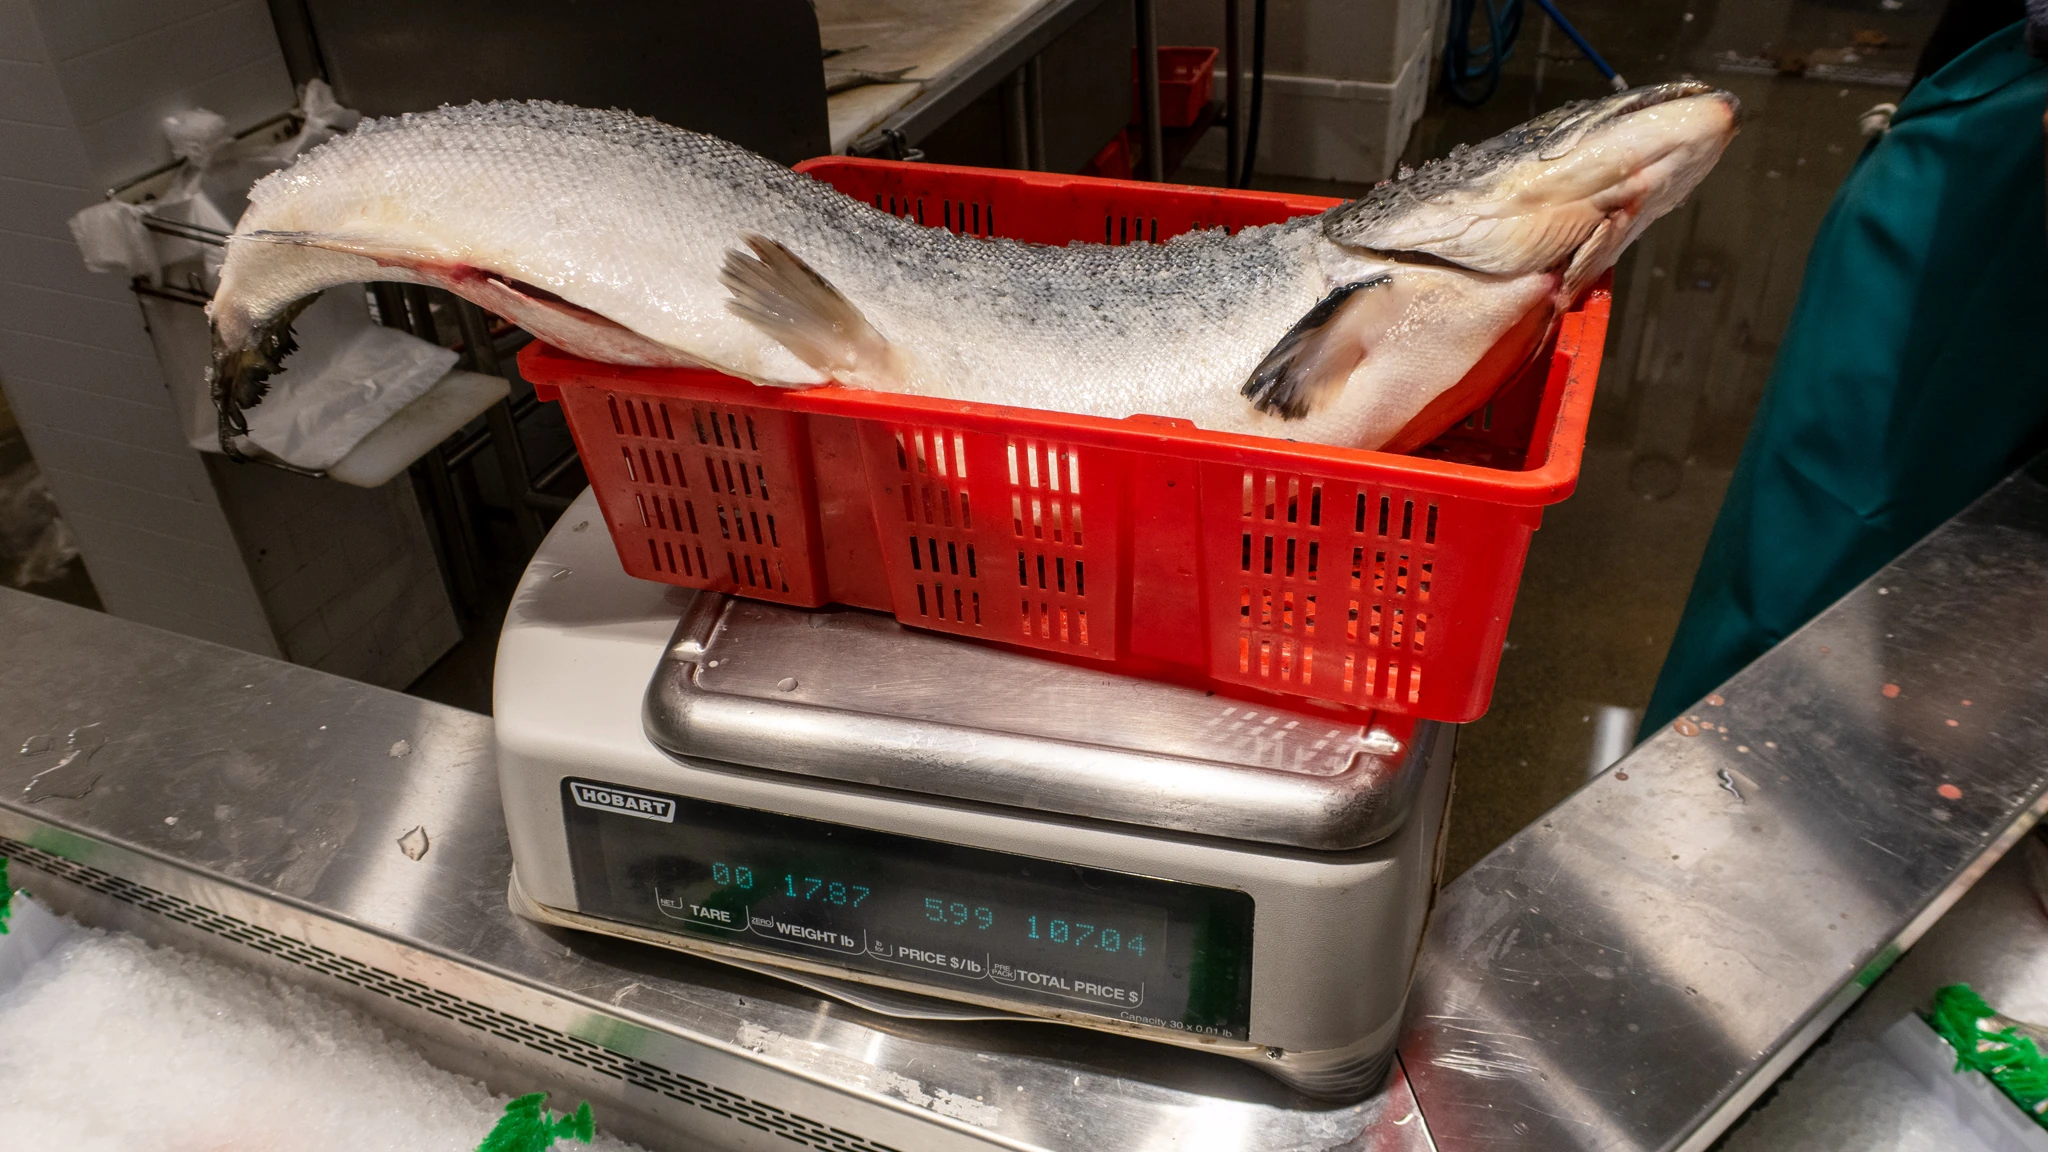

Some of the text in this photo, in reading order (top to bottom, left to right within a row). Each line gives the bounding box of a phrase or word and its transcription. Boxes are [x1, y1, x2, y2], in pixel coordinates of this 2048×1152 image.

[582, 789, 665, 814] HOBART
[713, 863, 752, 888] 00
[661, 898, 675, 906] NET
[785, 875, 869, 907] 17.87
[690, 904, 731, 922] TARE
[751, 917, 772, 926] ZERO
[925, 898, 992, 930] 5.99
[776, 922, 854, 947] WEIGHT lb
[1028, 916, 1145, 956] 107.04
[899, 946, 981, 973] PRICE $/lb
[994, 963, 1010, 972] PRE
[992, 969, 1014, 979] PACK
[1017, 969, 1139, 1004] TOTAL PRICE $
[1121, 1010, 1166, 1028] Capacity
[1170, 1020, 1183, 1030] 30
[1223, 1029, 1233, 1039] lb
